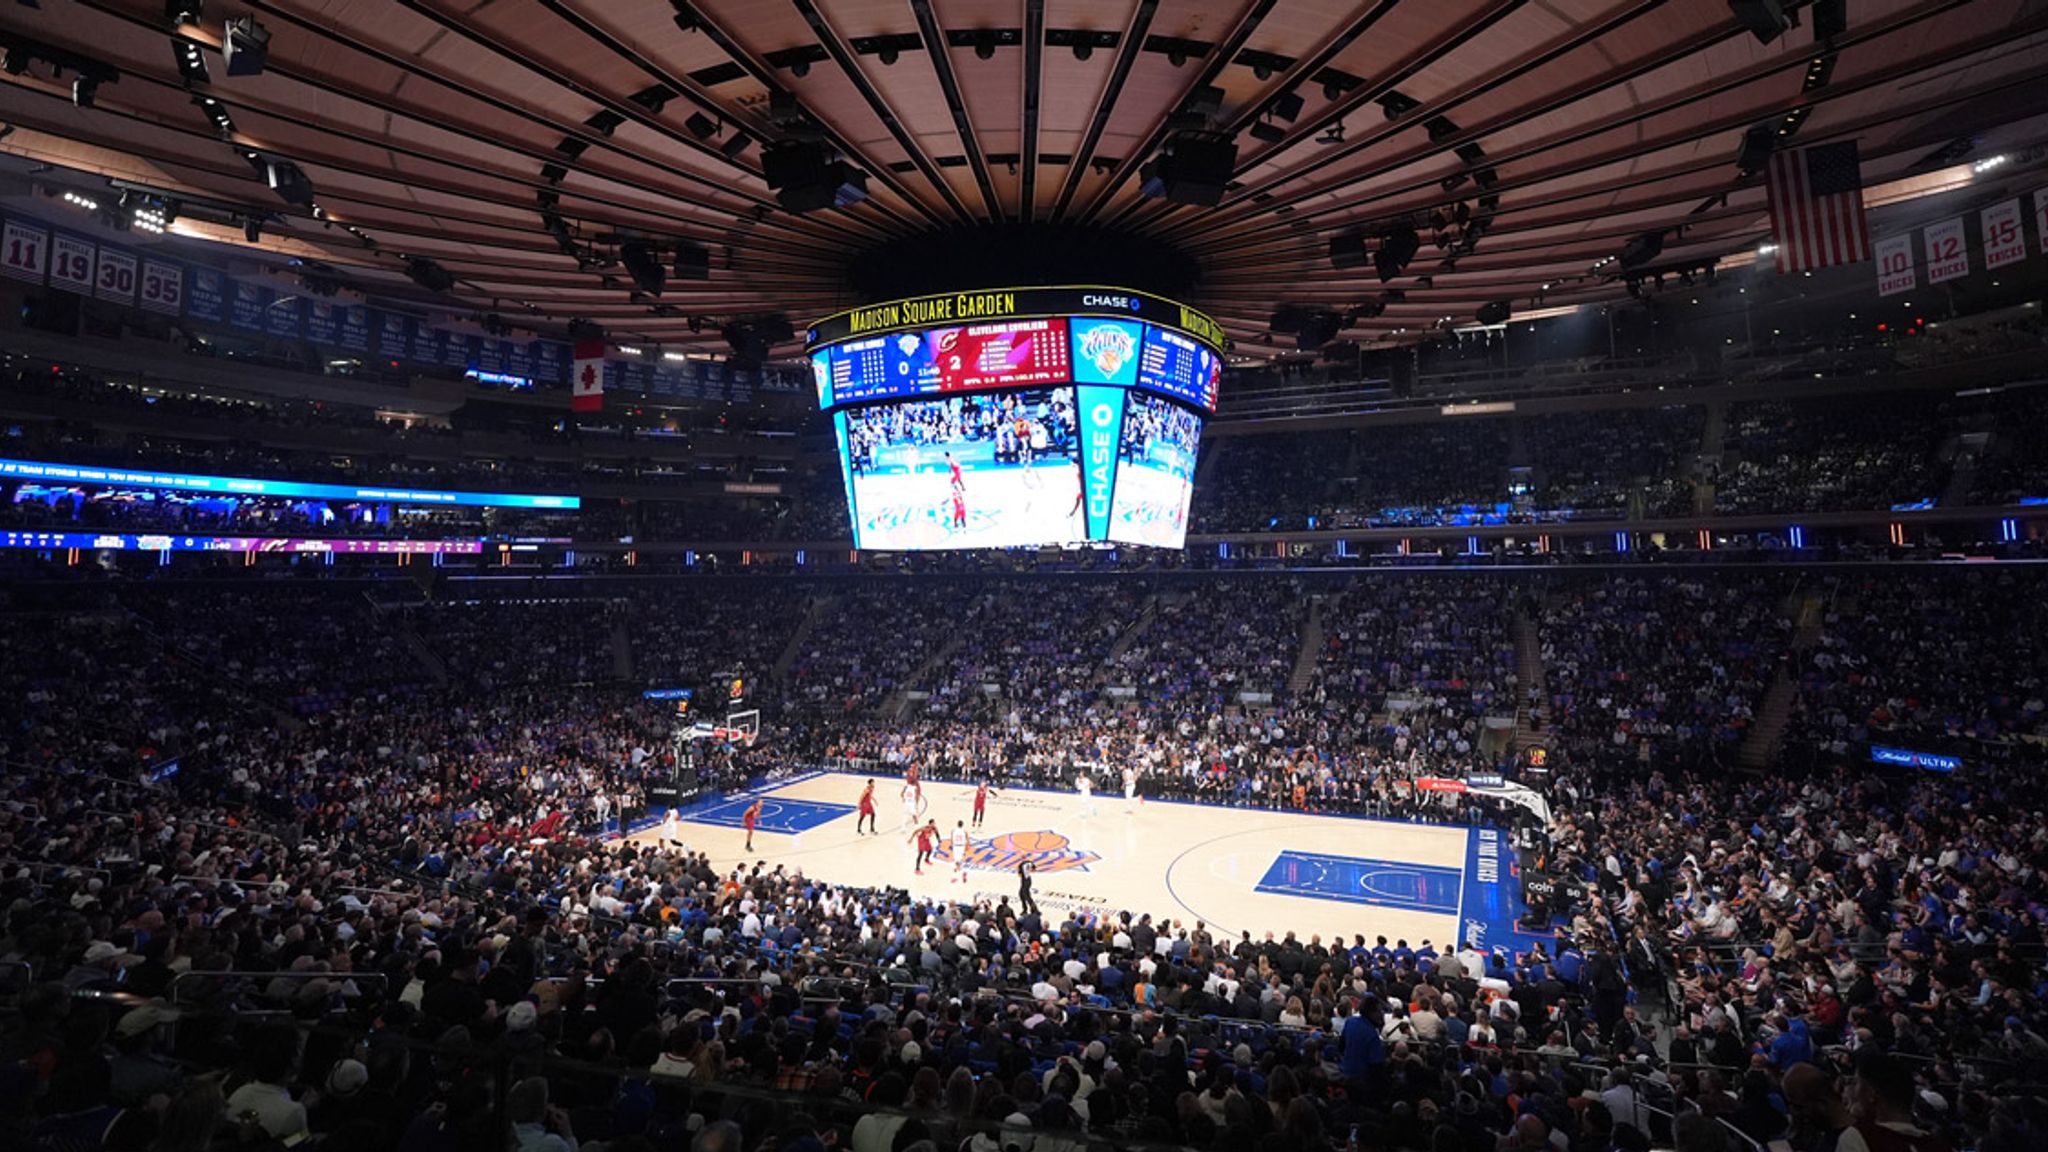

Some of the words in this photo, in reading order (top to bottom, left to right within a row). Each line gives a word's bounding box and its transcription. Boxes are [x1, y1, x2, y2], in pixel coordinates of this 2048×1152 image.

[1989, 219, 2016, 247] 15
[8, 239, 37, 269] 11
[1933, 237, 1959, 263] 12
[1987, 245, 2024, 265] KNICKS
[57, 252, 89, 281] 19
[1883, 253, 1907, 275] 10
[1930, 261, 1967, 279] KNICKS
[100, 264, 133, 292] 30
[145, 275, 178, 303] 35
[1881, 276, 1914, 291] KNICKS
[1083, 295, 1129, 308] CHASE
[850, 306, 899, 334] MADISON
[903, 298, 953, 324] SQUARE
[957, 293, 1015, 317] GARDEN
[898, 361, 909, 375] 0
[950, 355, 961, 370] 2
[4, 464, 17, 472] AT
[18, 465, 43, 474] TEAM
[79, 470, 106, 479] WHEN
[108, 472, 125, 481] YOU
[1091, 430, 1111, 518] CHASE
[1920, 757, 1955, 768] ULTRA
[1477, 858, 1499, 883] KNICKS
